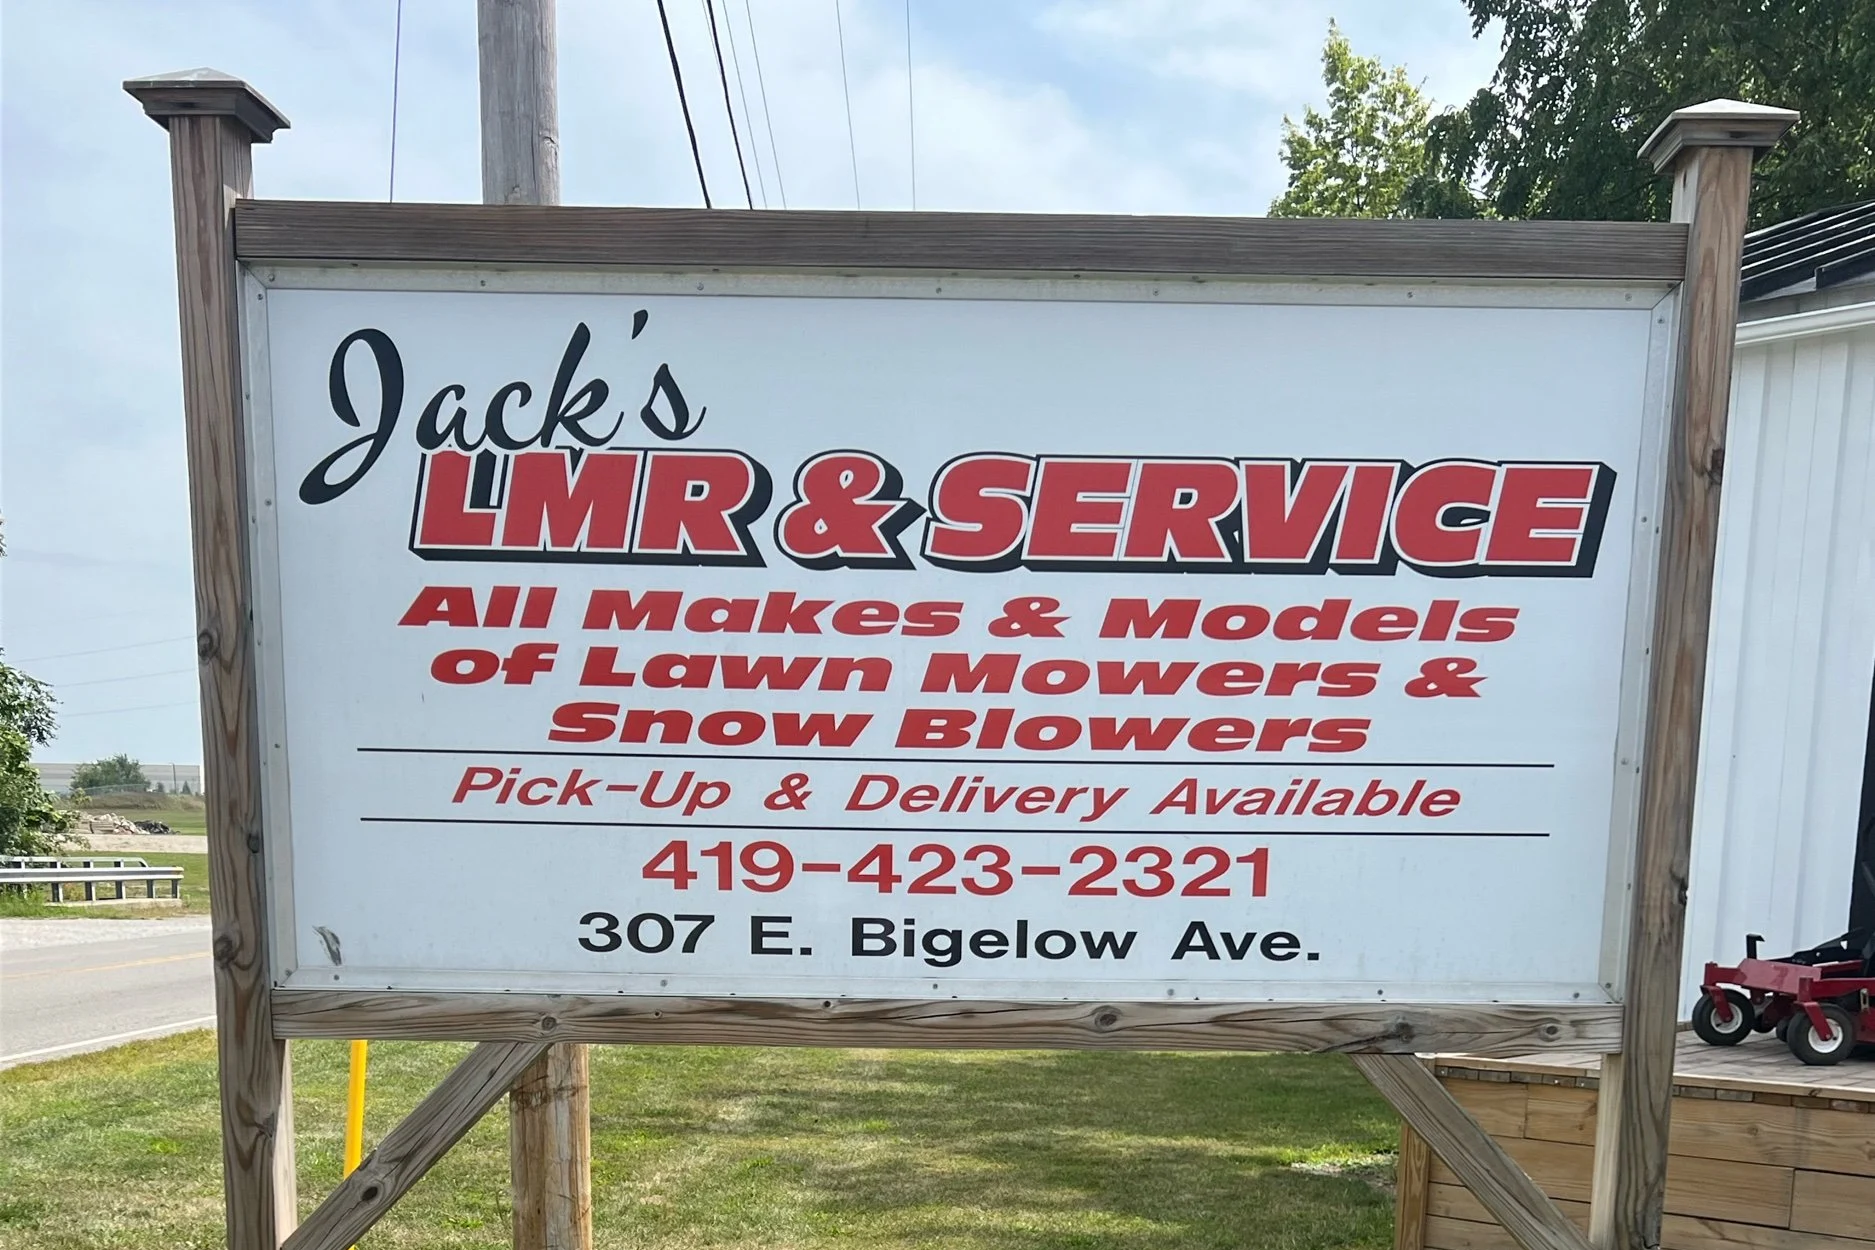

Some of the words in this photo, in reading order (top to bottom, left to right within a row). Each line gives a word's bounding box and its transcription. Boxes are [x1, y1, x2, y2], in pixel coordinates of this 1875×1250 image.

[298, 309, 706, 505] Jack's
[408, 447, 772, 568] LMR
[774, 450, 925, 571] &
[920, 452, 1617, 579] SERVICE
[399, 586, 556, 628] All
[583, 589, 964, 636] Makes
[988, 596, 1072, 639] &
[1100, 598, 1520, 643] Models
[430, 642, 559, 685] of
[580, 646, 893, 692] Lawn
[920, 653, 1381, 698] Mowers
[1404, 656, 1487, 699] &
[548, 701, 874, 748] Snow
[895, 708, 1371, 754] Blowers
[452, 766, 732, 816] Pick-Up
[764, 772, 812, 811] &
[845, 773, 1127, 823] Delivery
[1150, 777, 1462, 817] Available
[641, 838, 1271, 898] 419-423-2321
[577, 910, 716, 955] 307
[750, 914, 813, 957] E.
[850, 916, 1138, 968] Bigelow
[1170, 920, 1321, 962] Ave.
